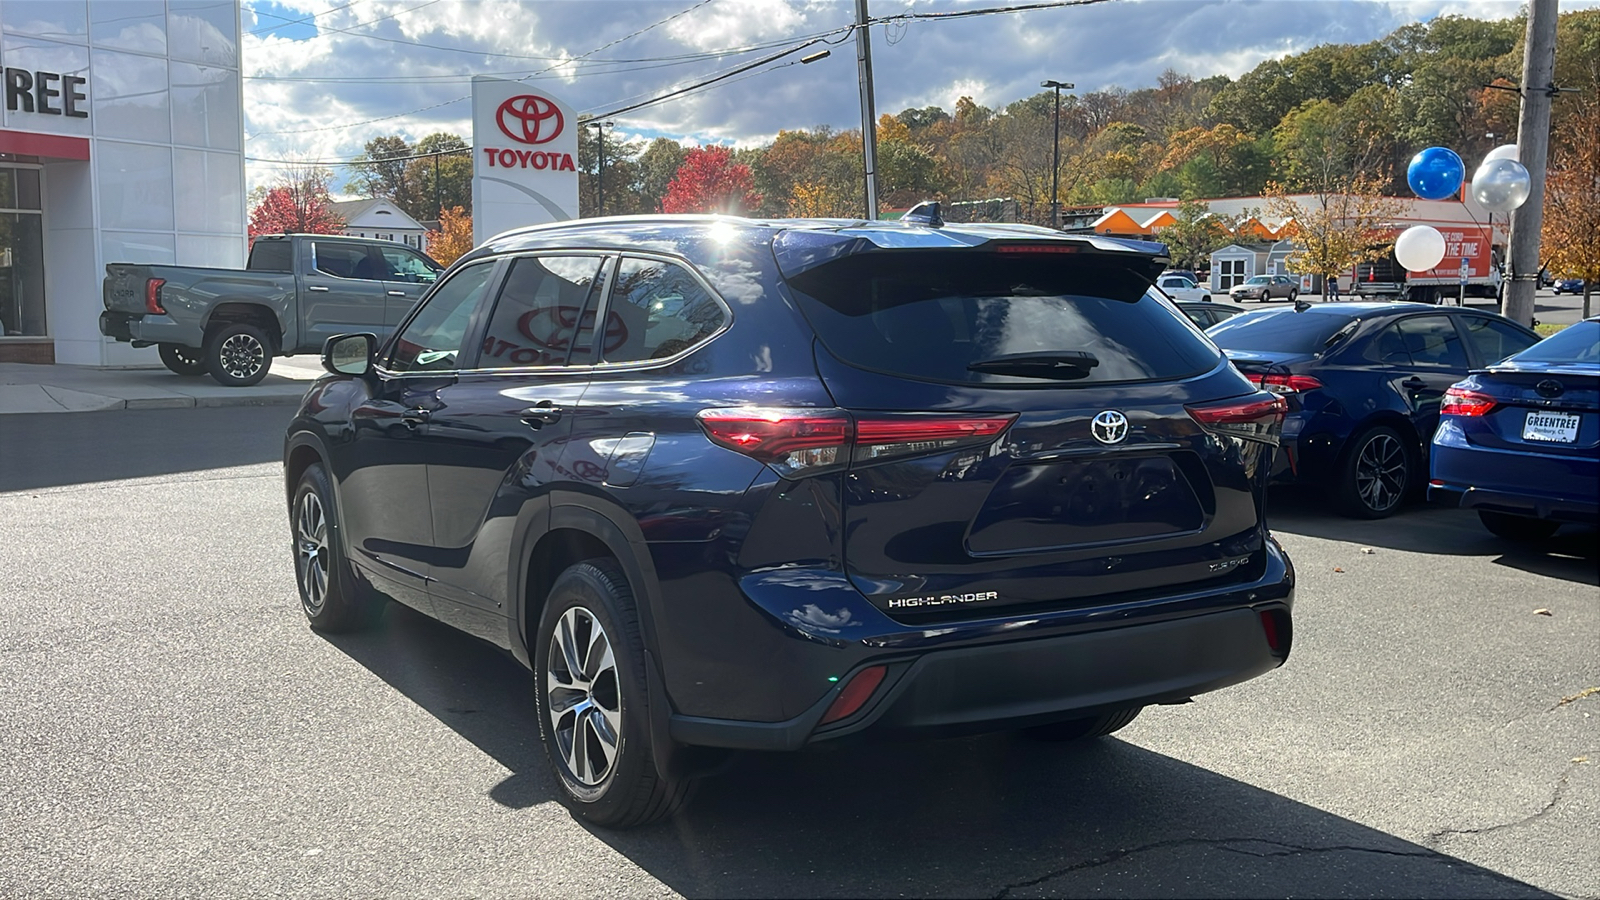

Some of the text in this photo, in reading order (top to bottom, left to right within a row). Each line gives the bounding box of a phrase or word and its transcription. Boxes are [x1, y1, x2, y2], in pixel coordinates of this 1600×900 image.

[0, 66, 88, 118] REE
[484, 148, 576, 172] TOYOTA
[1446, 242, 1460, 256] THE
[1528, 416, 1577, 429] GREENTREE
[888, 591, 998, 608] HIGHLANDER
